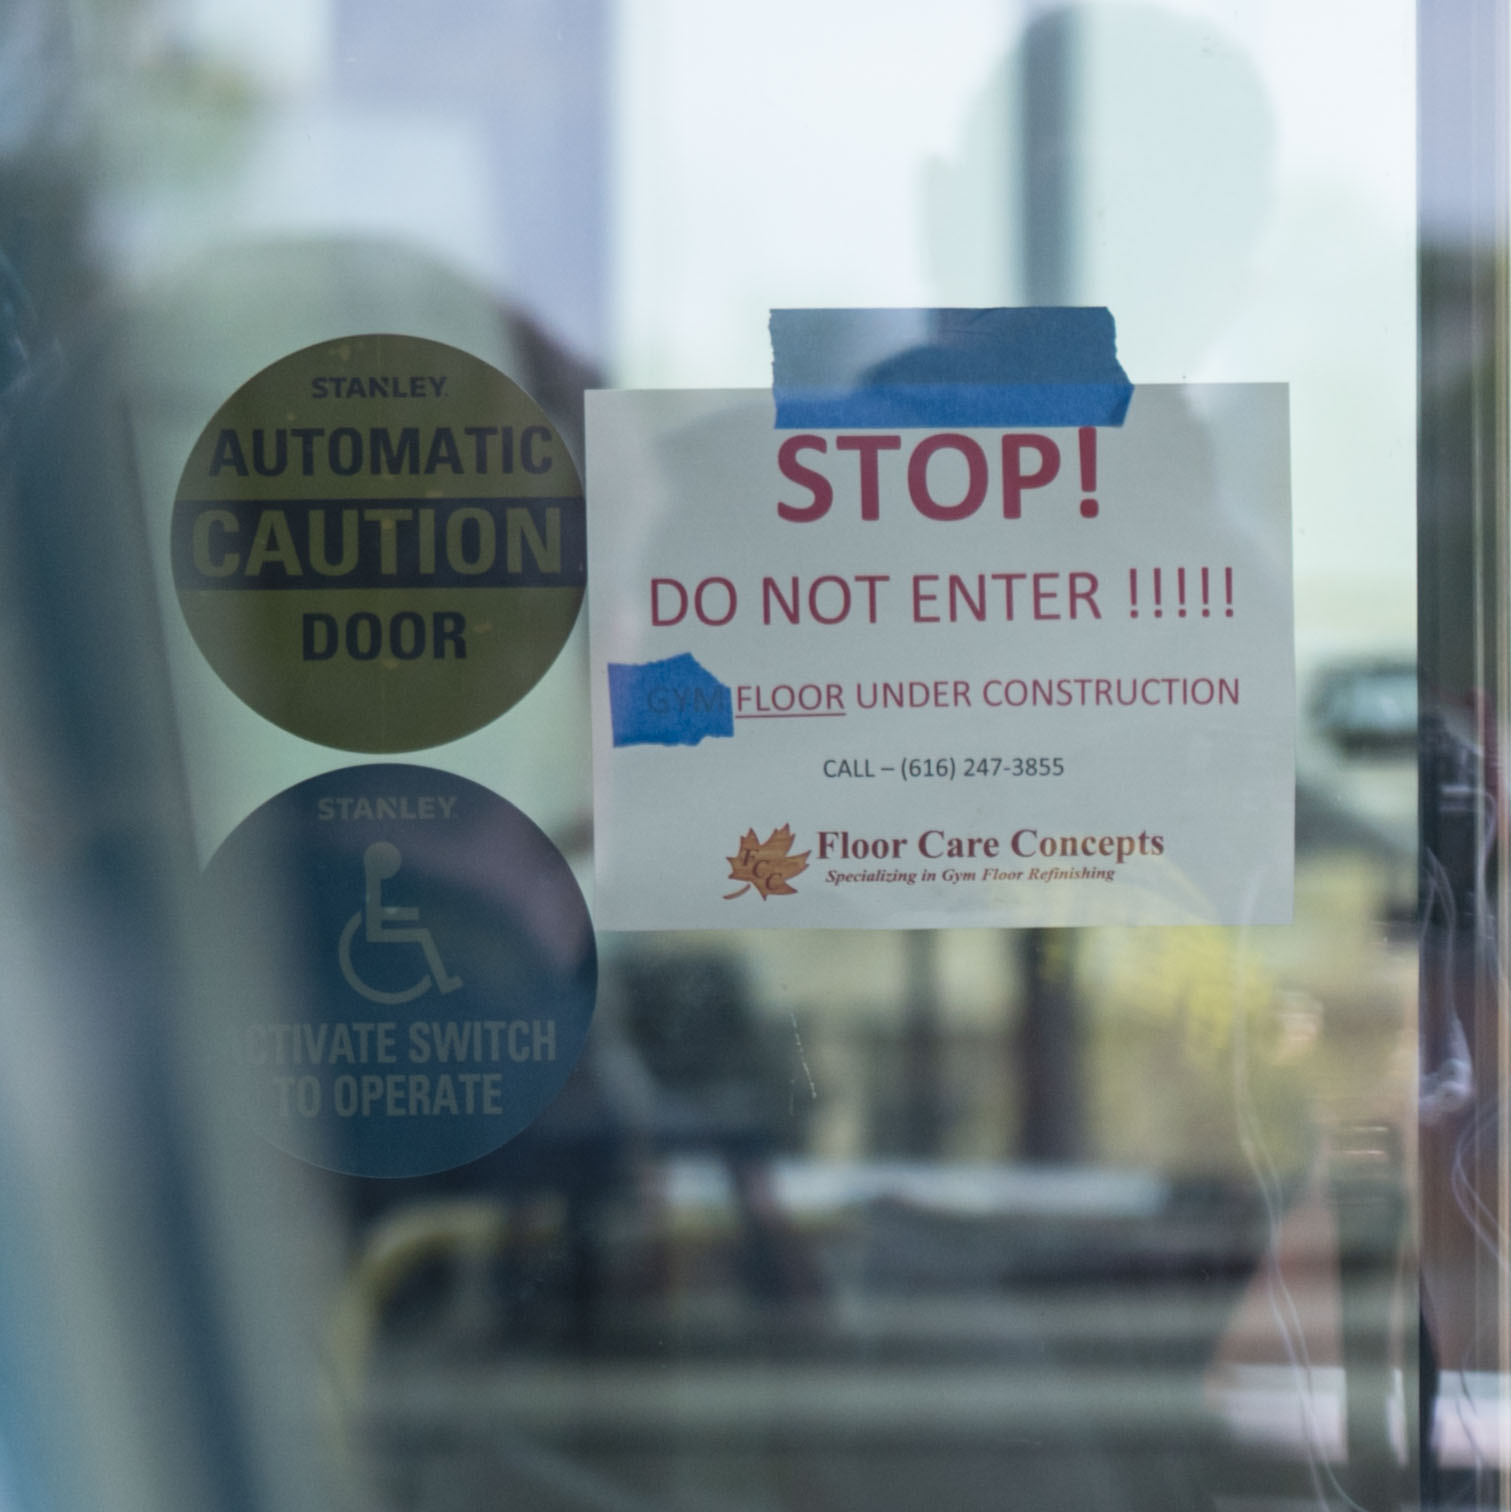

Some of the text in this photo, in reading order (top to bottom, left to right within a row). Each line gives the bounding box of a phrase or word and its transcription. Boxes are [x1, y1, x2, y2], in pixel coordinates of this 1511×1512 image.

[312, 376, 448, 398] STANLEY
[209, 425, 553, 477] AUTOMATIC
[777, 426, 1099, 524] STOP!
[192, 507, 562, 578] CAUTION
[650, 567, 1236, 627] DO NOT ENTER !!!!!
[301, 611, 467, 661] DOOR
[736, 684, 845, 713] FLOOR
[857, 680, 971, 709] UNDER
[983, 676, 1240, 708] CONSTRUCTION
[822, 758, 876, 779] CALL
[901, 757, 956, 782] (616)
[964, 757, 1065, 779] 247-3855
[318, 798, 458, 820] STANLEY
[816, 829, 1165, 865] Floor Care Concepts
[825, 866, 1115, 886] Specializing in Gym Floor Refinishing
[409, 1020, 556, 1062] SWITCH
[273, 1073, 503, 1118] TO OPERATE
